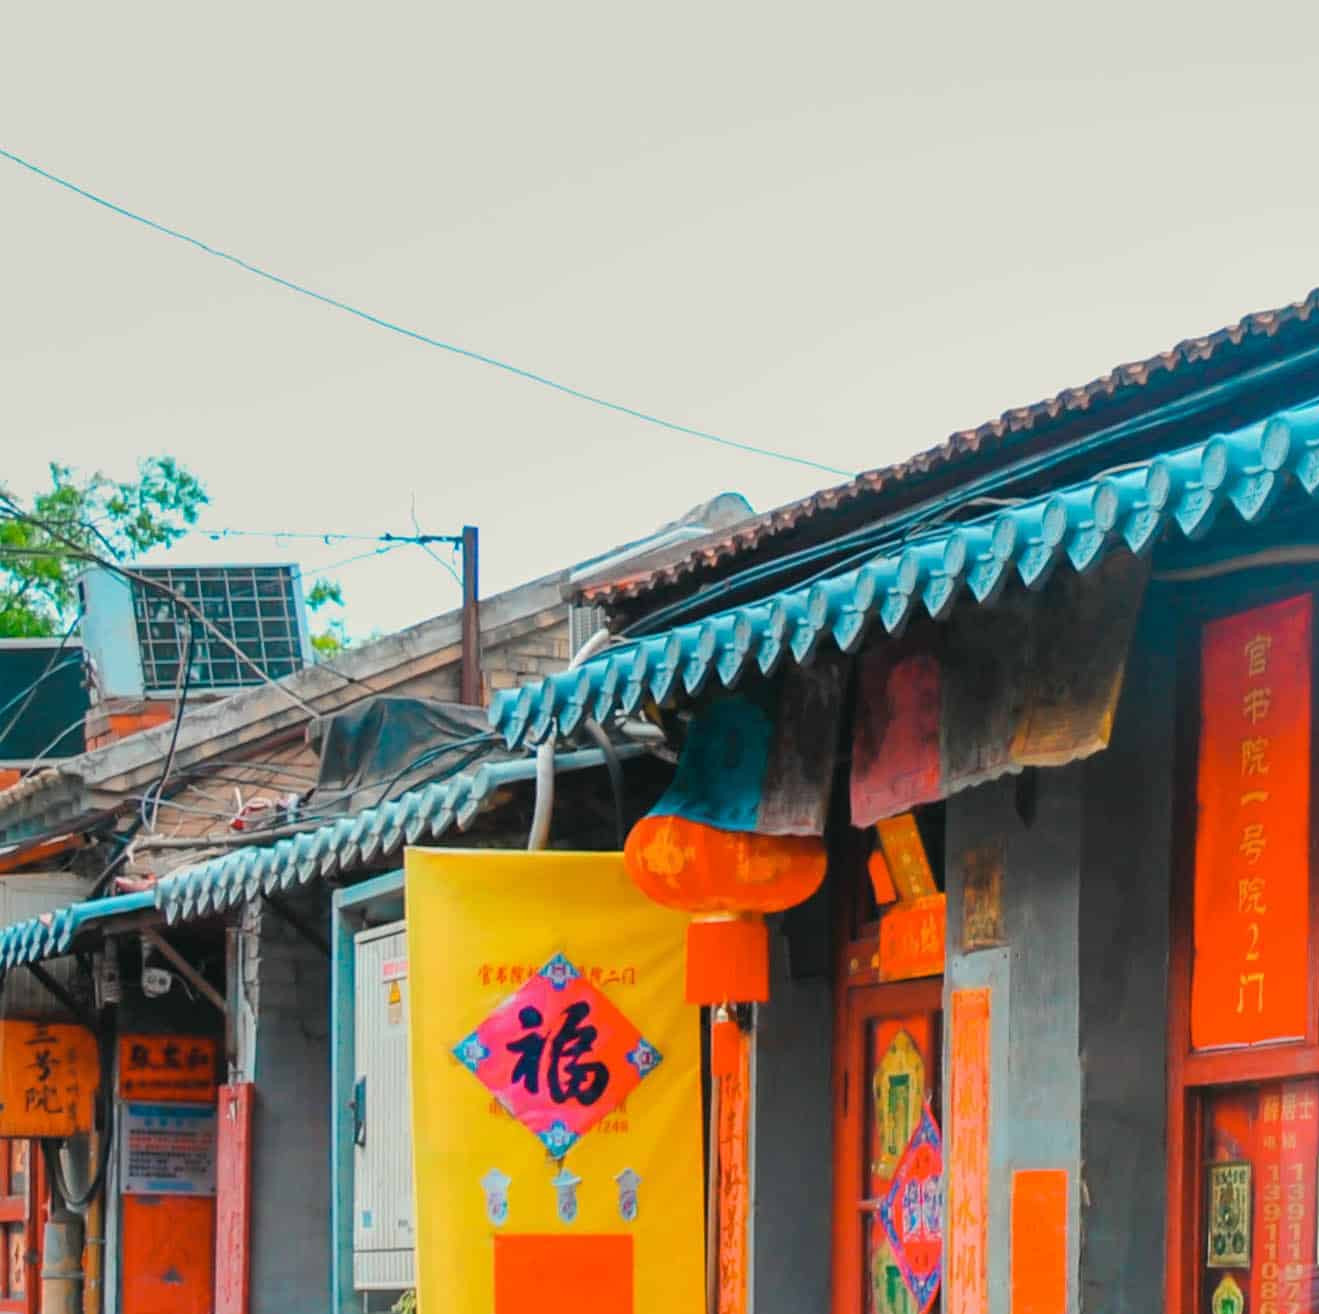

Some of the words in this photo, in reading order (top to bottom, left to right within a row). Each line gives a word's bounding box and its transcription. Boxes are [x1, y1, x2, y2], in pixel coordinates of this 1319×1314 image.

[1236, 634, 1273, 1015] 官书院一号院2门
[506, 1000, 610, 1107] 福
